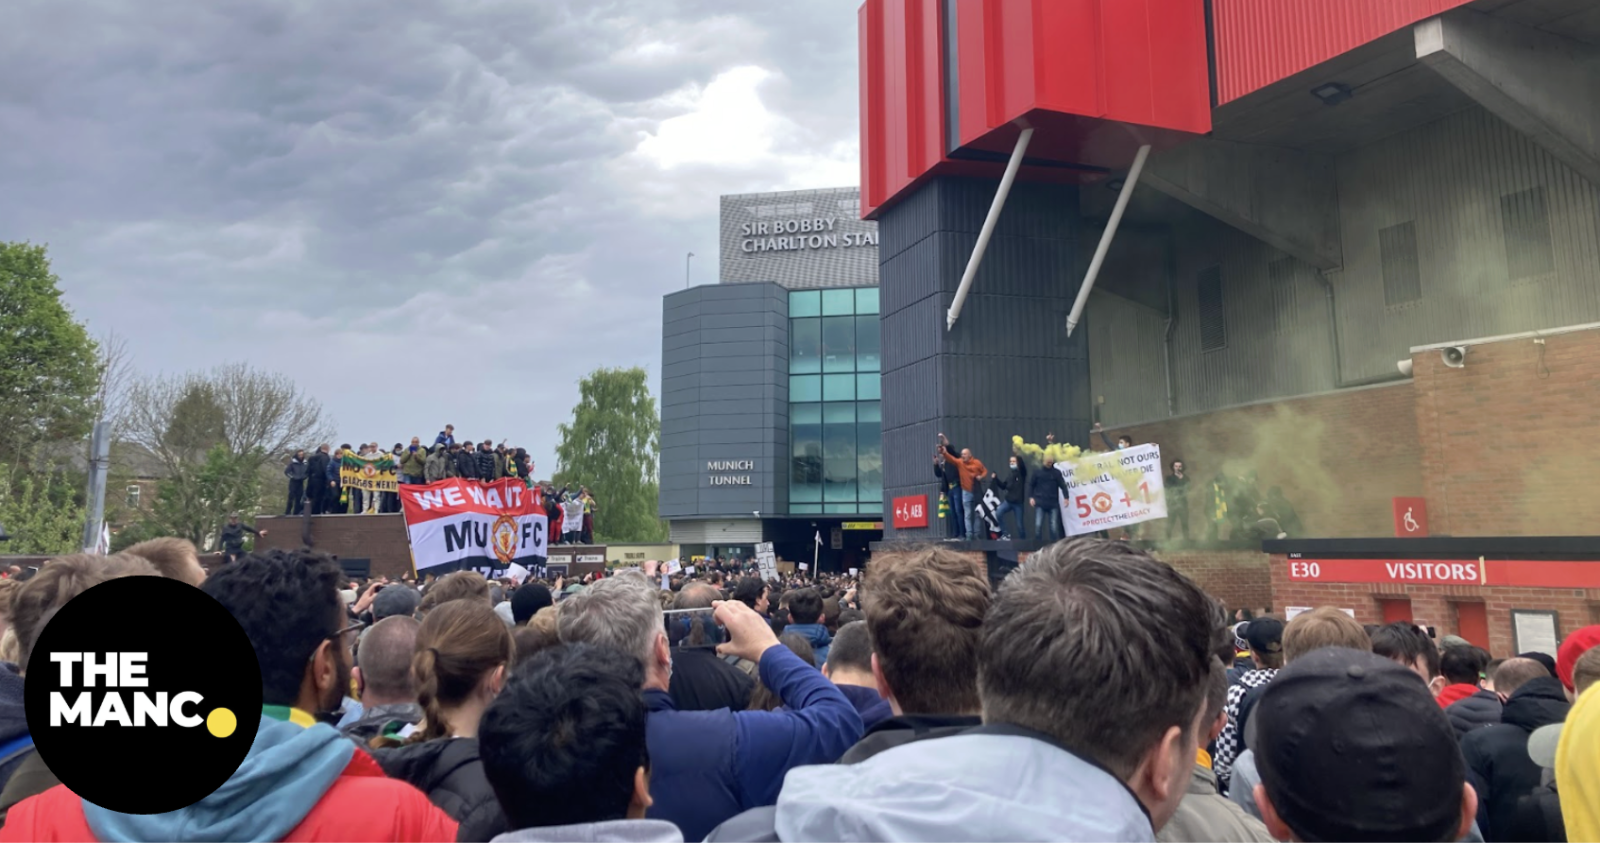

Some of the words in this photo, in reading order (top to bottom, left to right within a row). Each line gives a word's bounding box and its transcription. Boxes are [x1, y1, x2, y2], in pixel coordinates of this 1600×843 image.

[741, 222, 769, 236] SIR
[773, 217, 836, 234] BOBBY
[741, 234, 837, 252] CHARLTON
[843, 231, 878, 247] STA
[708, 460, 754, 470] MUNICH
[1118, 456, 1134, 466] NOT
[1137, 451, 1159, 462] OURS
[1140, 463, 1154, 474] DIE
[709, 475, 752, 485] TUNNEL
[413, 486, 466, 511] WE
[466, 486, 522, 508] WANT
[911, 504, 923, 518] AEB
[1291, 562, 1320, 578] E30
[1385, 562, 1478, 580] VISITORS
